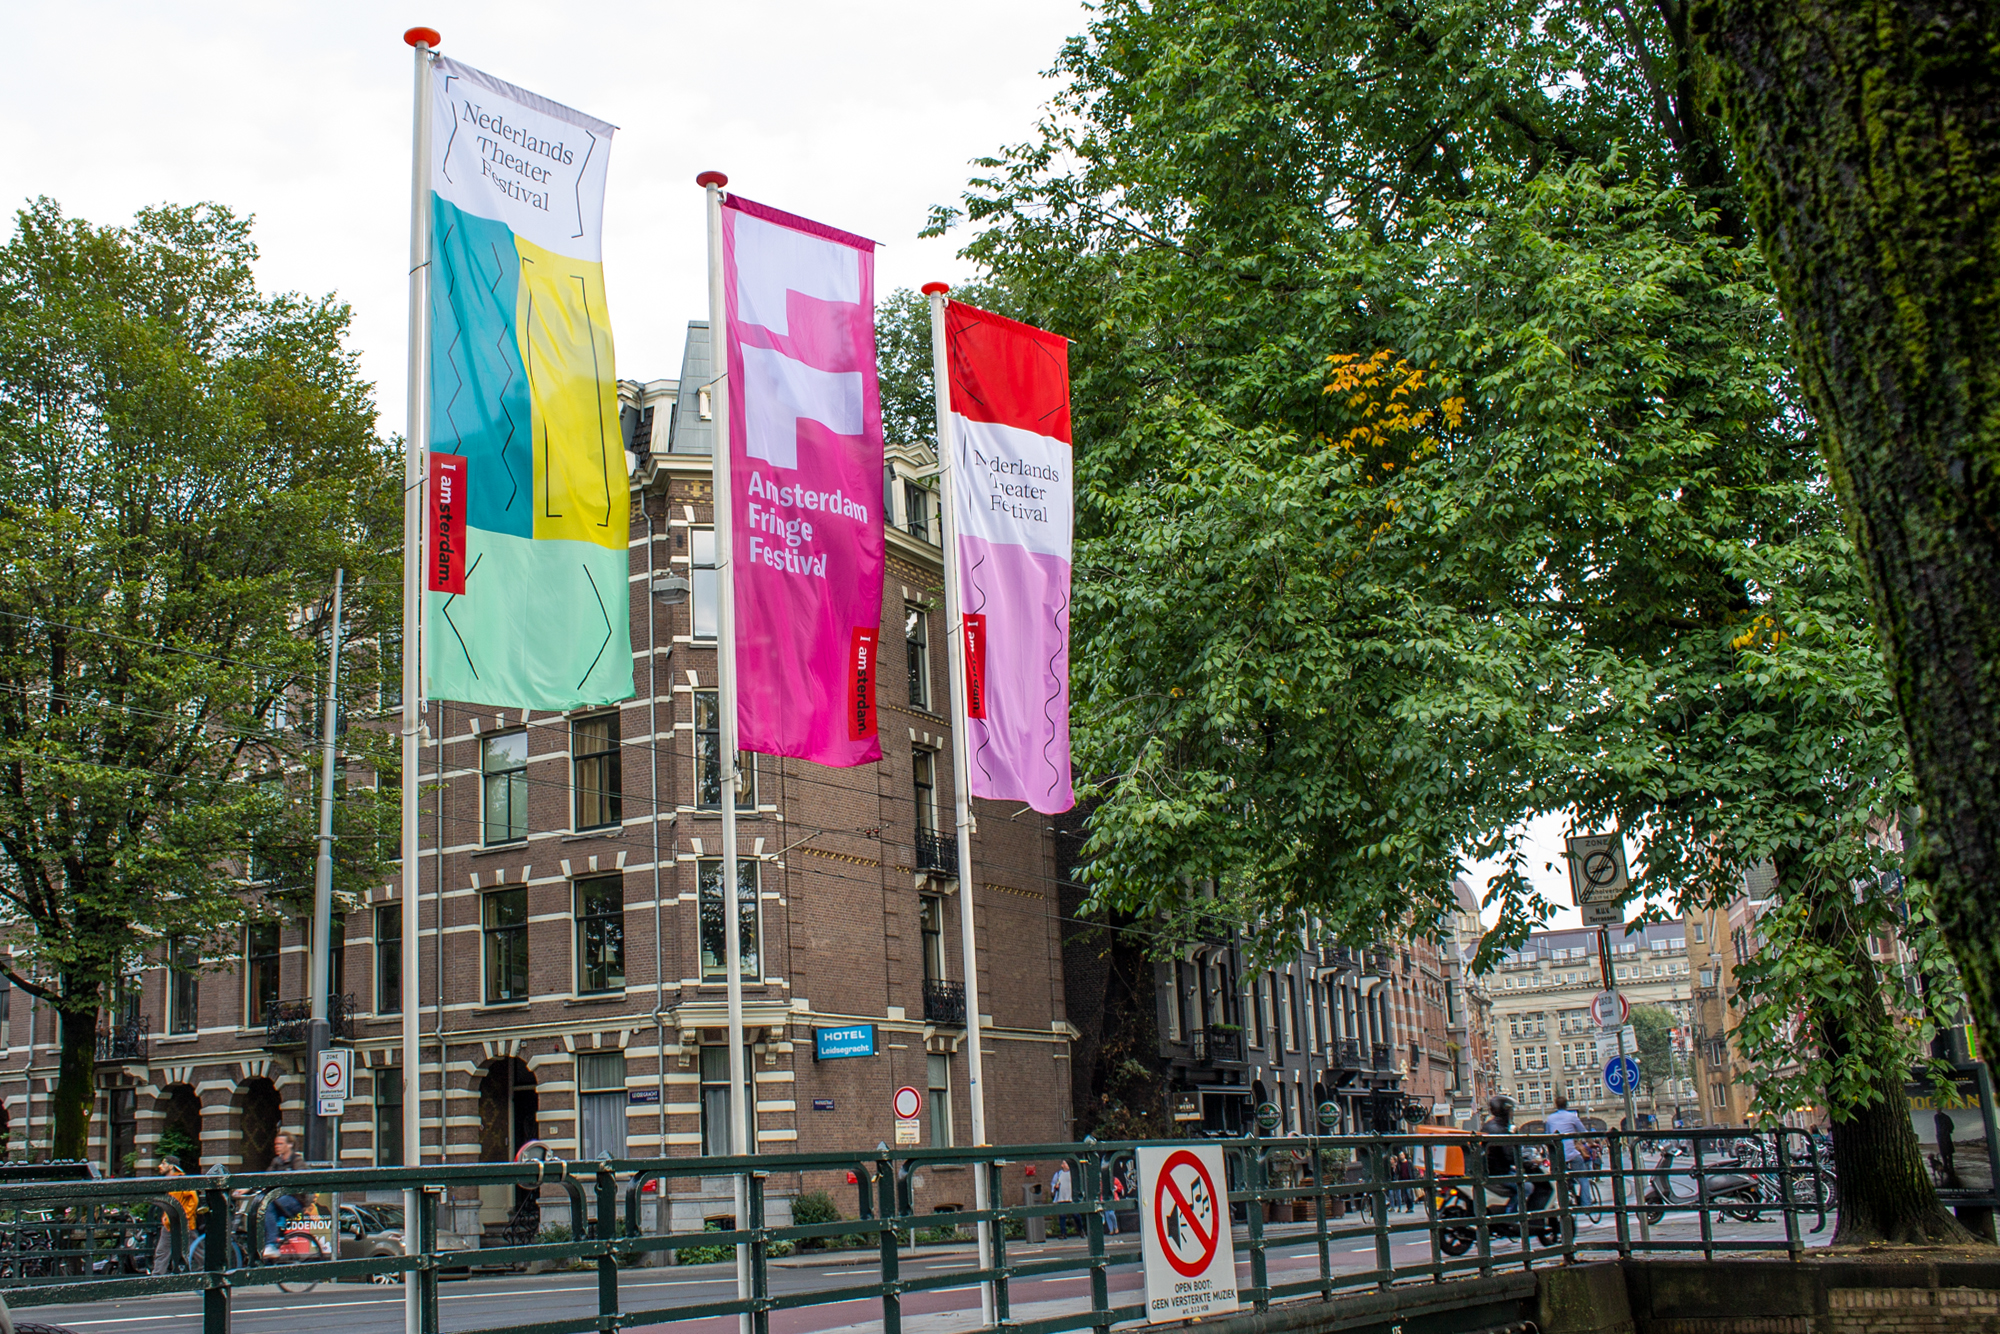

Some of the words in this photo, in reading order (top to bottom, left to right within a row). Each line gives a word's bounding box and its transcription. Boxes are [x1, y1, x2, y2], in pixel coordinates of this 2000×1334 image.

[462, 100, 573, 165] Nederlands
[476, 136, 552, 185] Theater
[481, 157, 550, 212] Festival
[441, 463, 456, 471] I
[974, 449, 1059, 482] Nderlands
[748, 470, 868, 524] Amsterdam
[990, 494, 1048, 523] Fetival
[748, 502, 813, 547] Fringe
[749, 536, 827, 579] Festival
[821, 1044, 870, 1055] Leidsegracht
[824, 1030, 866, 1041] HOTEL
[1151, 1298, 1169, 1310] GEEN
[1171, 1292, 1211, 1307] VERSTERKTE
[1212, 1288, 1236, 1301] MUZIEK
[1174, 1281, 1192, 1294] OPEN
[1193, 1279, 1213, 1291] BOOT:
